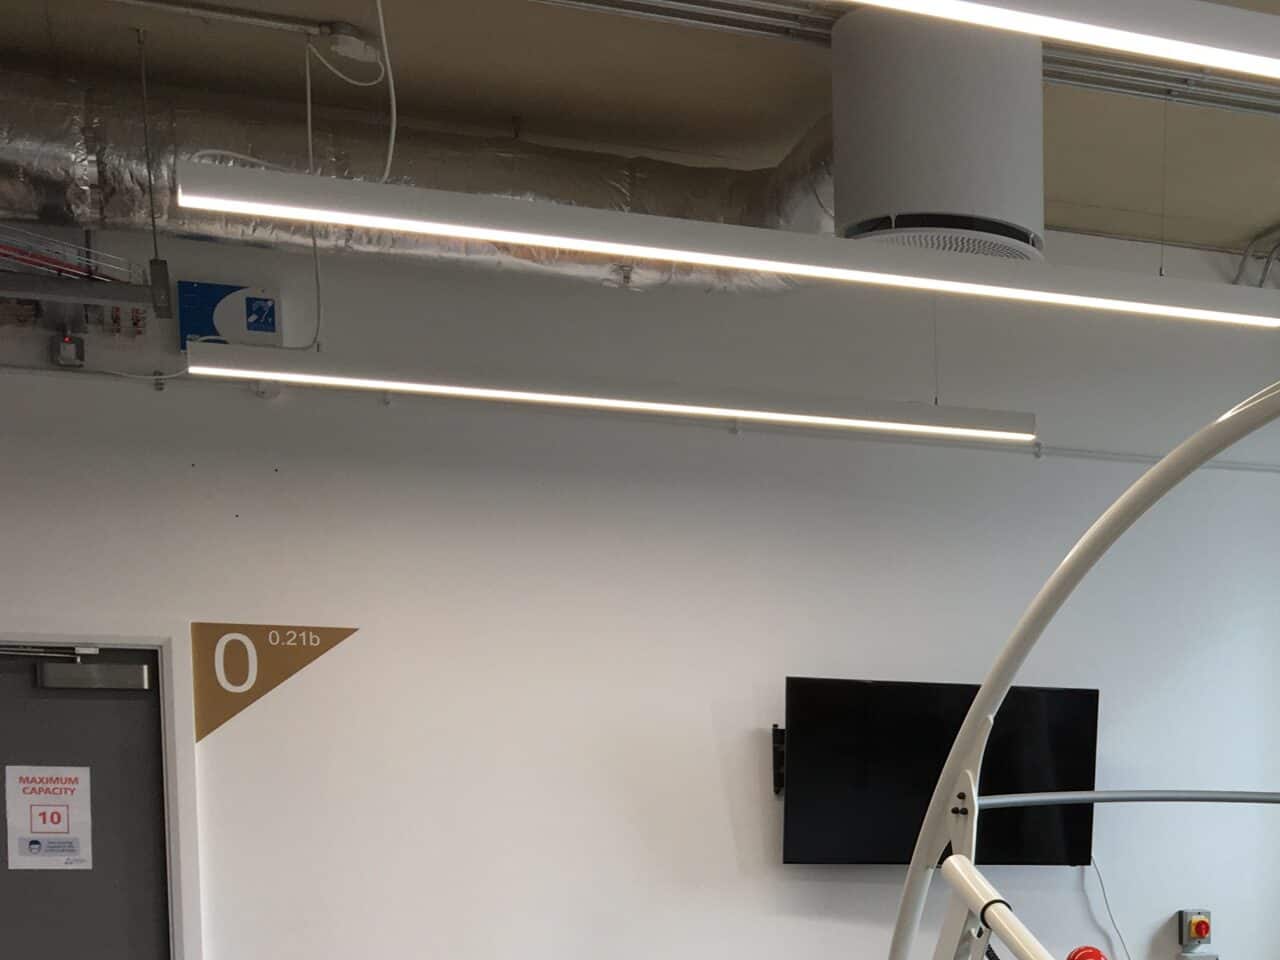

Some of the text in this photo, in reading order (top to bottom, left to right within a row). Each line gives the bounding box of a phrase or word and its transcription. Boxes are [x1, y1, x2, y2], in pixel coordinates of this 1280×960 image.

[267, 630, 321, 647] 0.21b
[18, 775, 79, 785] MAXIMUM
[22, 786, 76, 796] CAPACITY
[38, 811, 62, 825] 10
